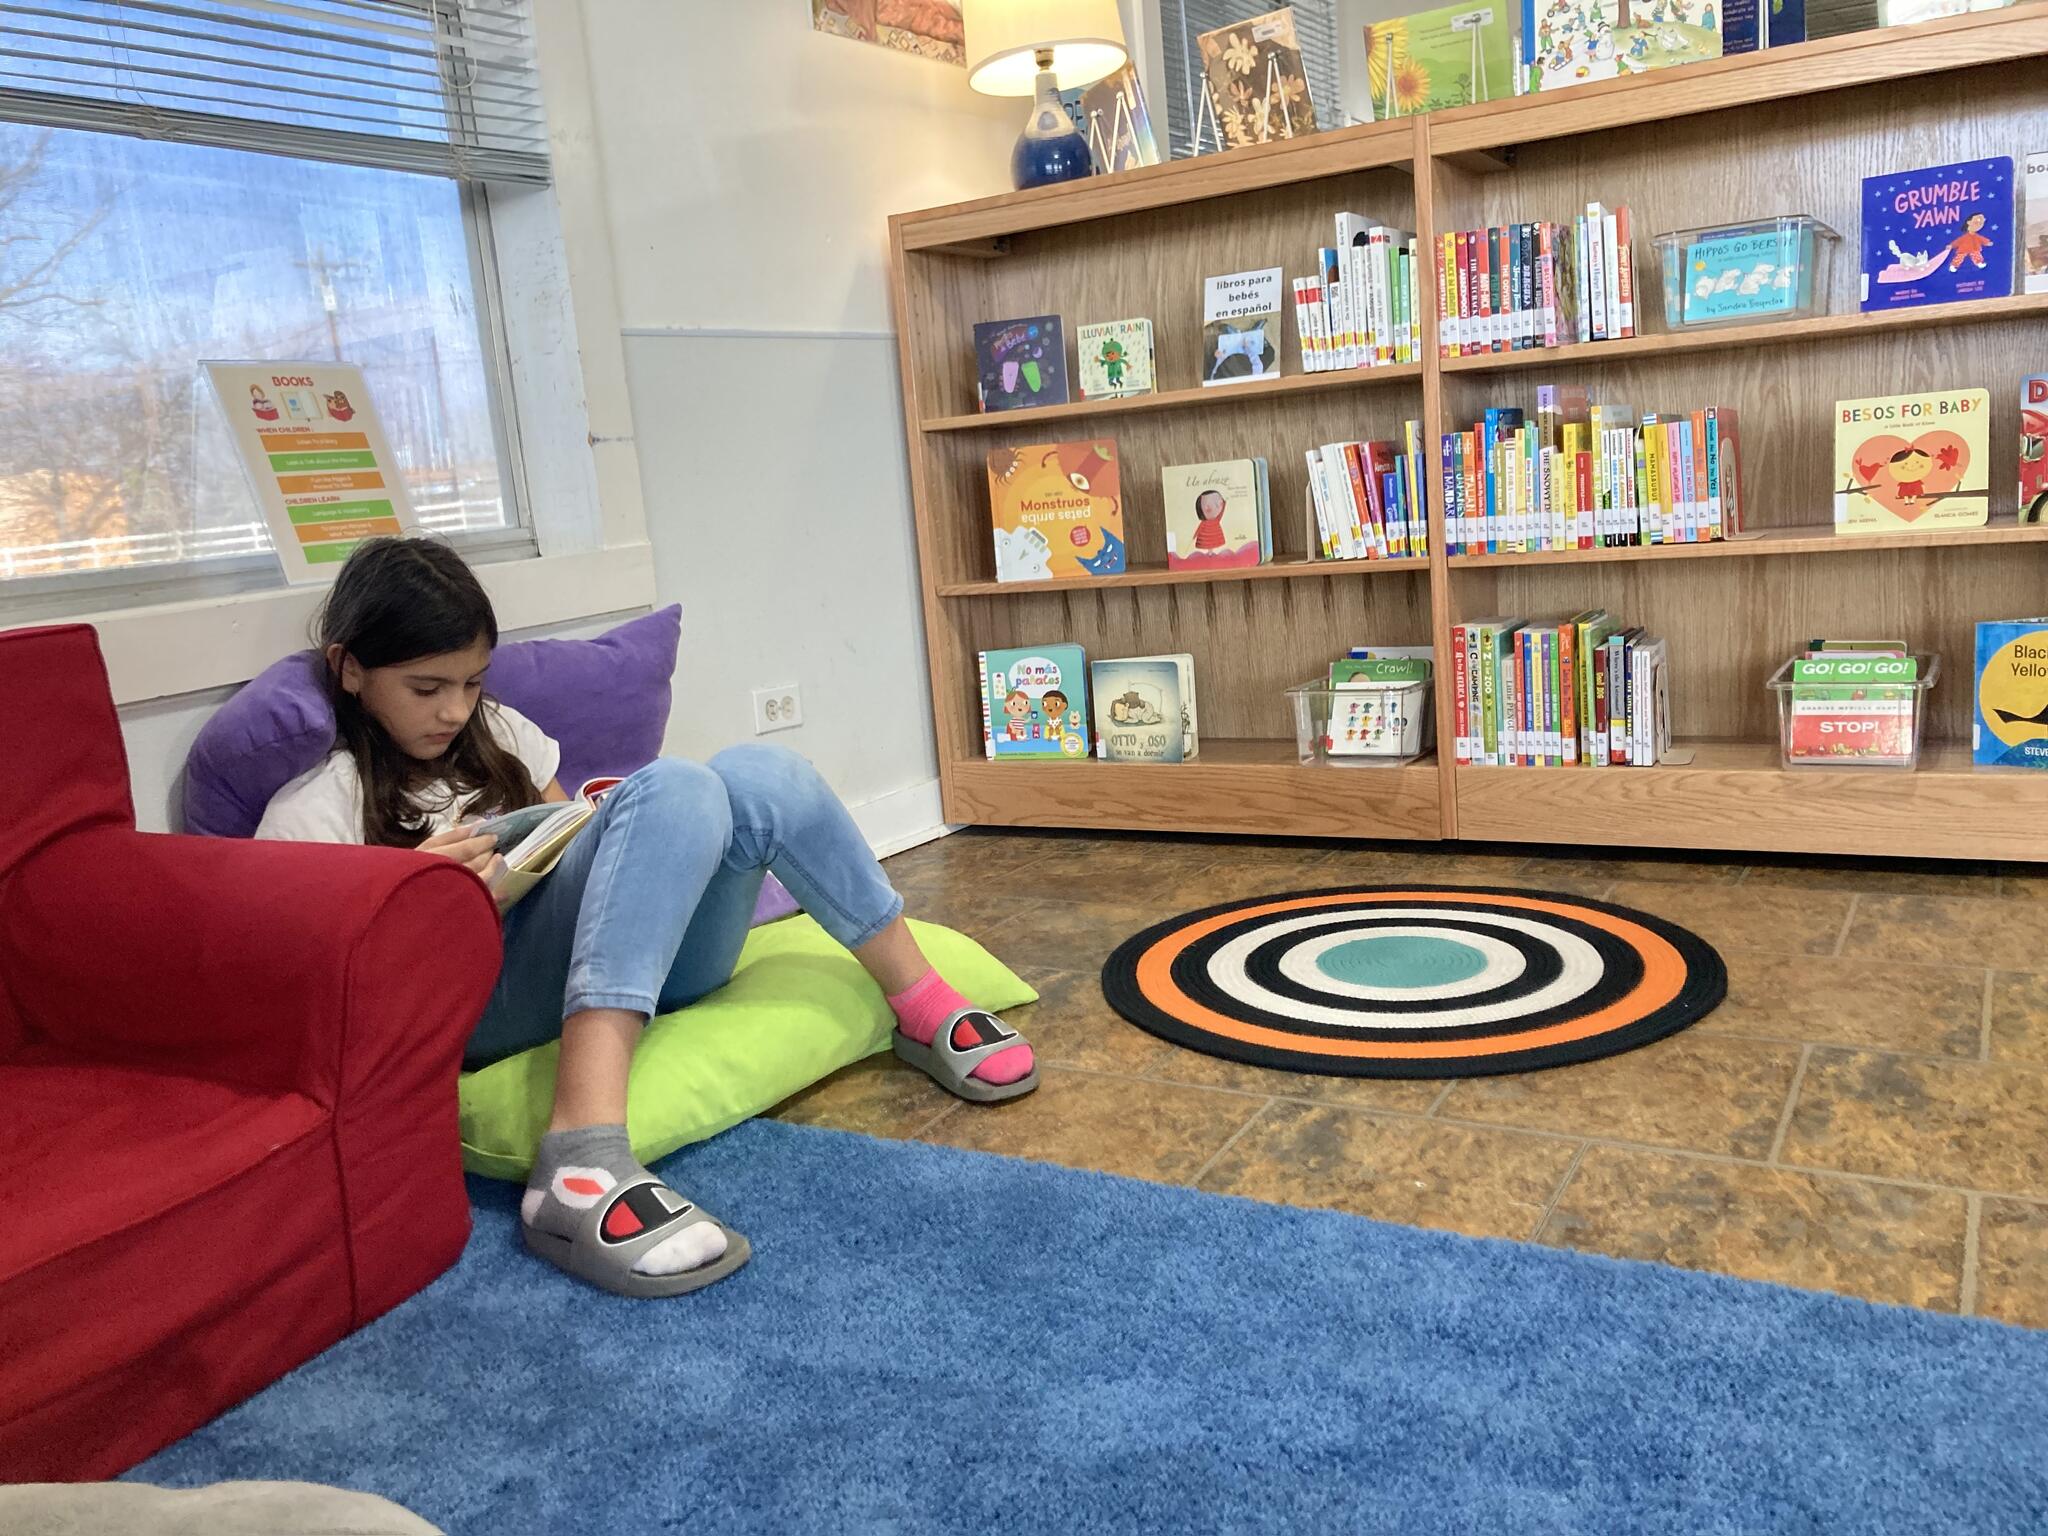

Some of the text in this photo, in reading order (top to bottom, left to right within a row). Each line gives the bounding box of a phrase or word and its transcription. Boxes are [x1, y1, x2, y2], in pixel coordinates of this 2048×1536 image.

[1895, 181, 1981, 214] GRUMBLE
[1913, 205, 1960, 229] YAWN
[1695, 244, 1729, 260] HIPPOS
[1734, 242, 1748, 253] GO
[1216, 275, 1273, 291] libros para
[1523, 263, 1531, 307] DRACULA
[1228, 289, 1260, 303] bebés
[1215, 302, 1272, 319] en español
[1718, 300, 1747, 313] Sandra
[1120, 322, 1145, 334] RAIN!
[272, 376, 314, 387] BOOKS
[1842, 398, 1982, 424] BESOS FOR BABY
[1543, 468, 1551, 501] SNOWY
[1649, 453, 1658, 502] MAMASAURUS
[1444, 476, 1455, 519] MANDARI
[1455, 474, 1465, 518] JAPANES
[1465, 474, 1476, 512] ITALIAN
[1020, 497, 1091, 513] Monstruos
[1021, 507, 1092, 525] patas arriba
[2014, 645, 2048, 659] Blac
[1017, 663, 1058, 676] No más
[1376, 662, 1414, 674] Crawl!
[1802, 662, 1909, 675] GO! GO! GO!
[1015, 674, 1060, 688] pañales
[1471, 670, 1479, 703] CAMPING
[1484, 676, 1492, 694] ZOO
[1596, 687, 1605, 699] DOG
[1507, 703, 1515, 731] PENGU
[1820, 721, 1879, 733] STOP!
[1112, 734, 1136, 746] OTTO
[1148, 734, 1167, 746] OSO
[1143, 748, 1164, 757] dormir
